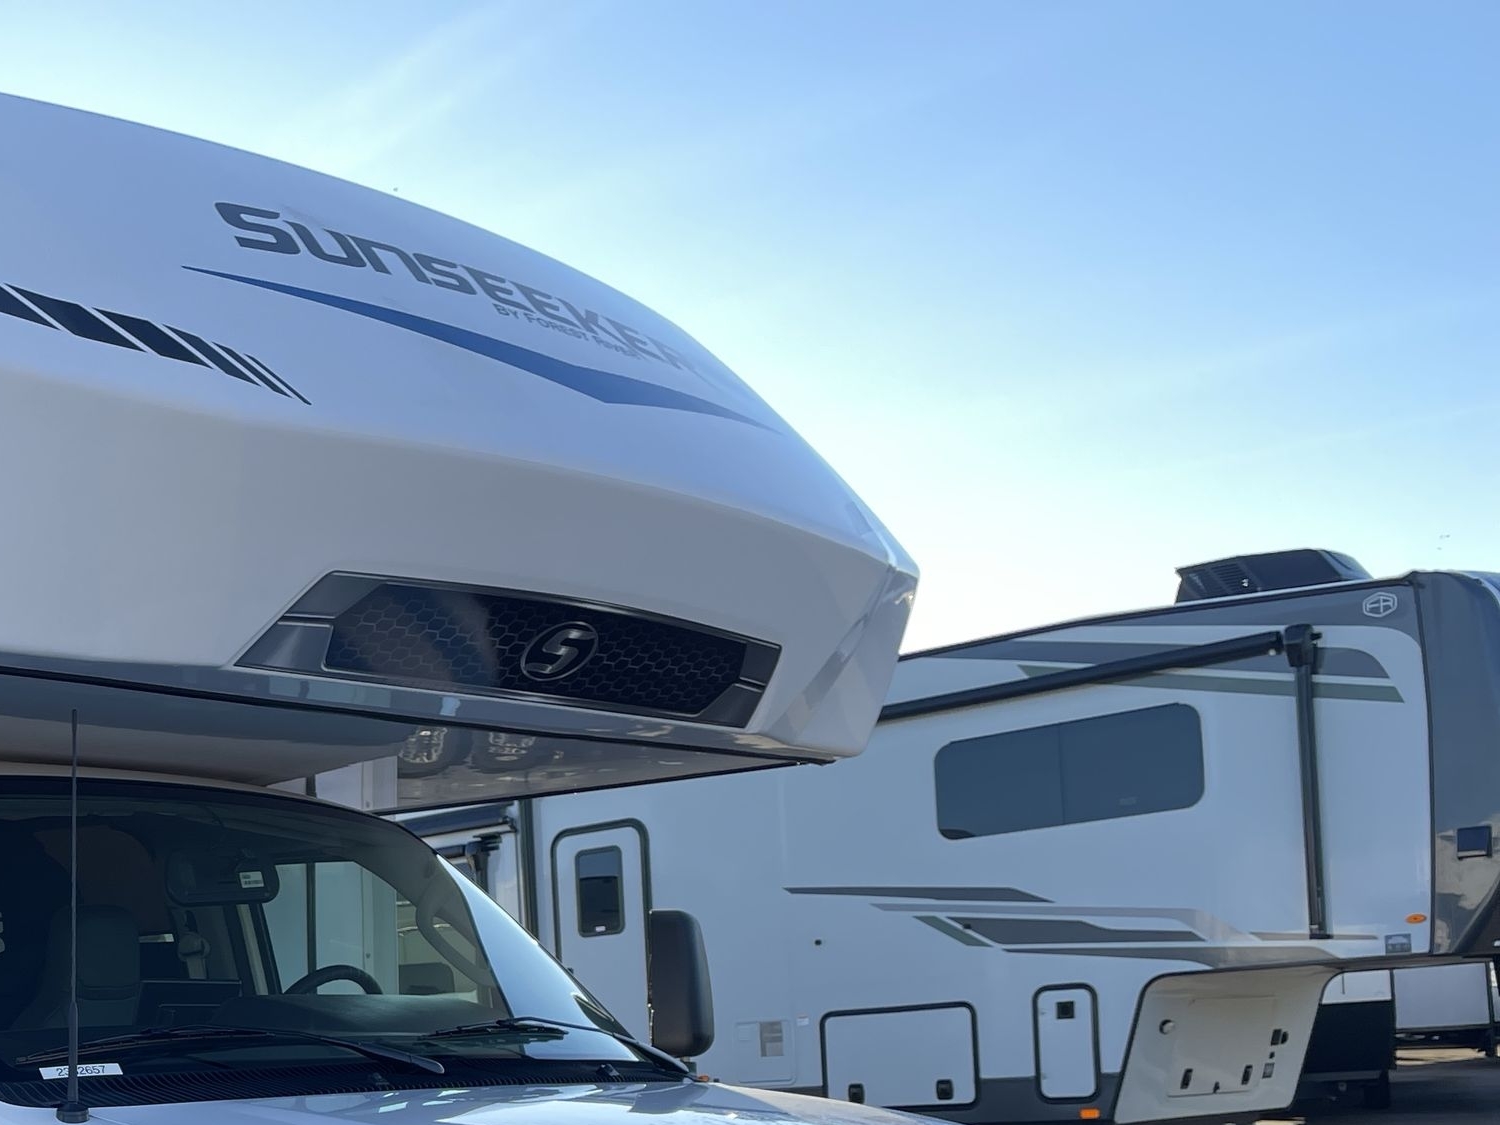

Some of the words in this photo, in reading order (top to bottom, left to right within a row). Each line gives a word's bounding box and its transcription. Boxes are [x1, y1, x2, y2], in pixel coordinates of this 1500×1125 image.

[214, 202, 690, 374] SUNSEEKER
[492, 302, 520, 320] BY
[56, 1065, 106, 1077] 232657
